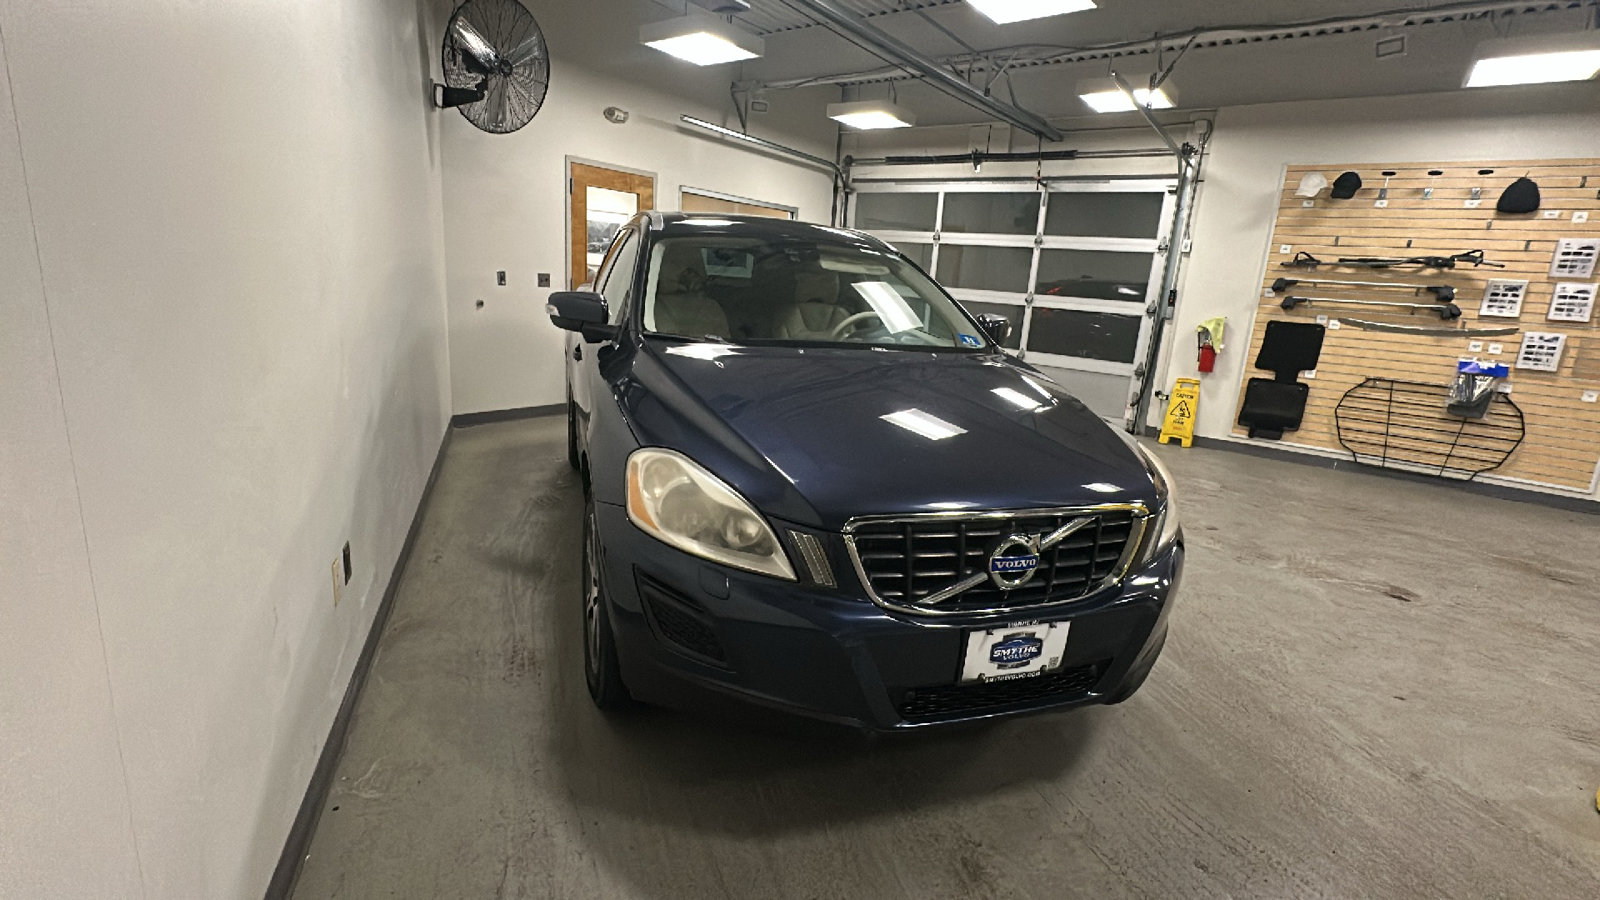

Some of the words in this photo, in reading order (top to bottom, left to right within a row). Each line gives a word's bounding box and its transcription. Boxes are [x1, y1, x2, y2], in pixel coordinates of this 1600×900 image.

[995, 559, 1036, 569] VOLVO
[992, 645, 1038, 658] SMYTHE
[1003, 652, 1031, 661] VOLVO
